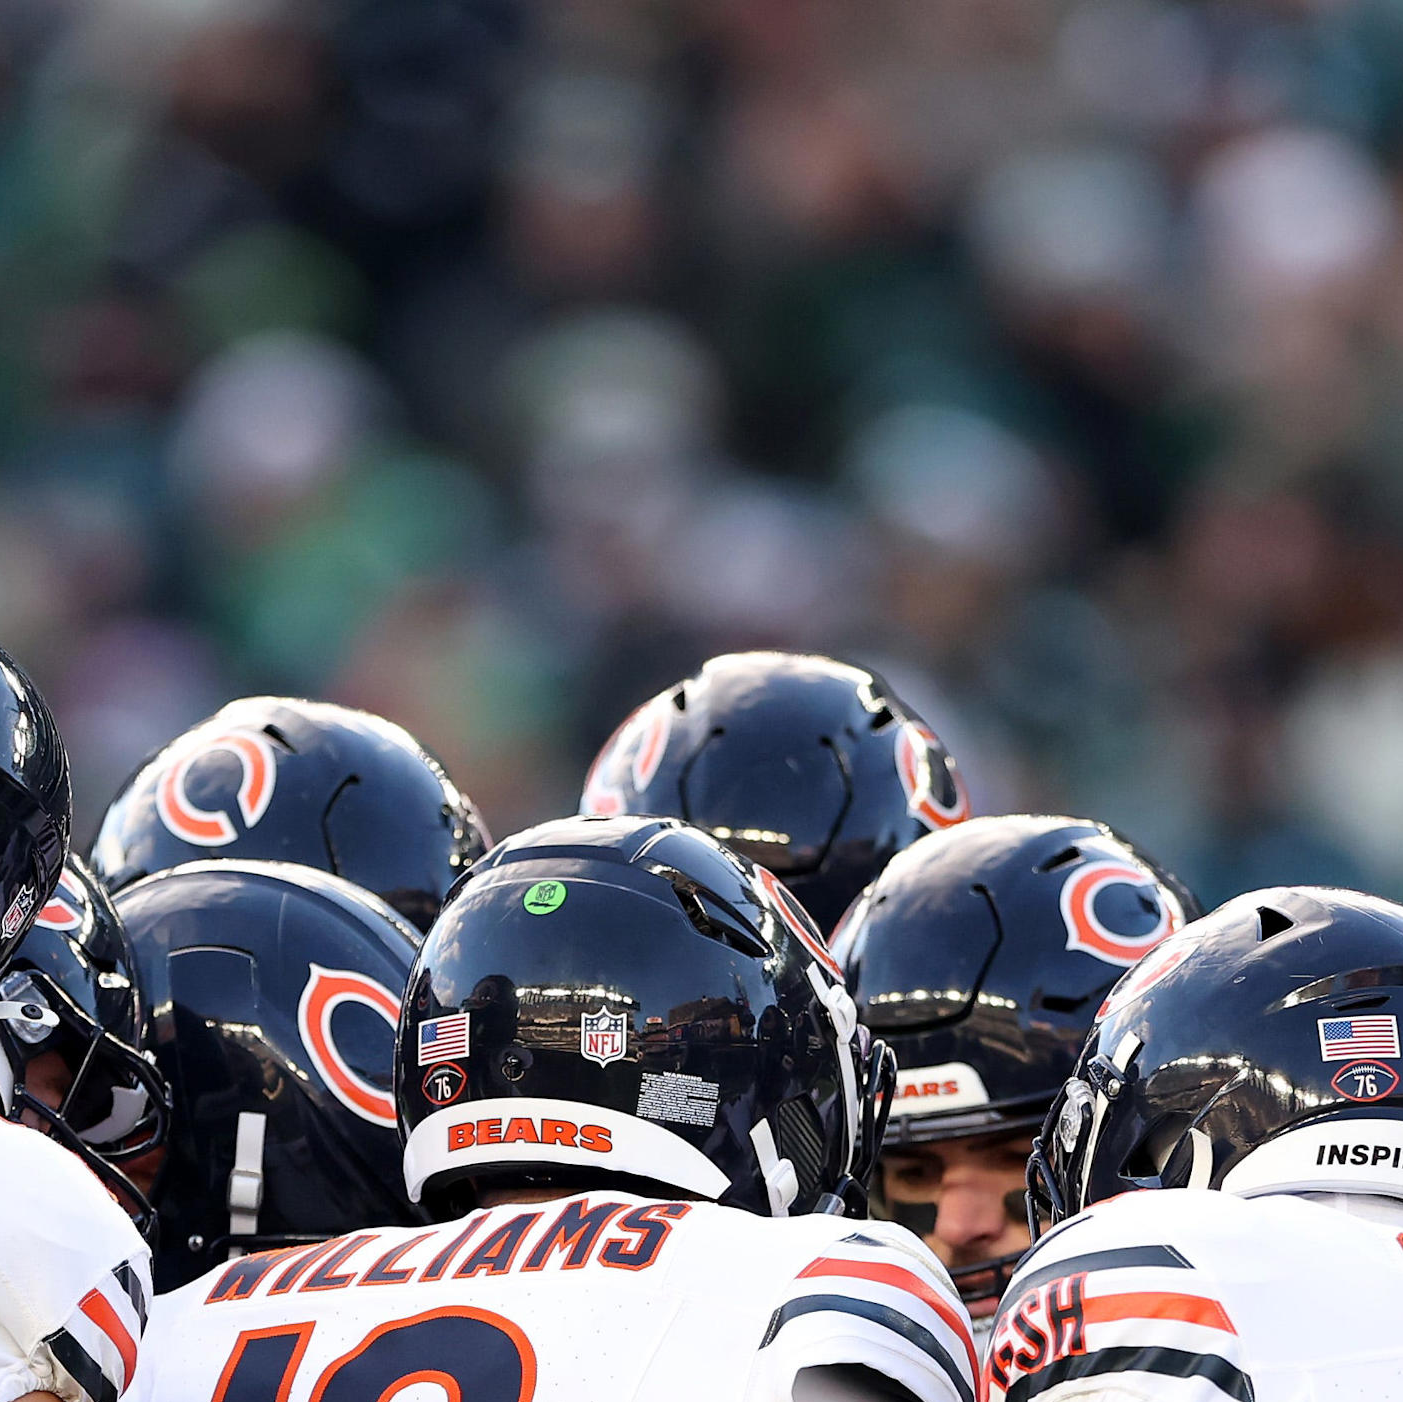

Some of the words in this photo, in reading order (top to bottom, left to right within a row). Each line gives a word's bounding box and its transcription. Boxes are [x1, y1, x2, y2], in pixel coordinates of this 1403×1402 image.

[587, 1030, 620, 1055] NFL
[434, 1077, 453, 1101] 76
[1354, 1074, 1378, 1098] 76
[447, 1118, 613, 1153] BEARS
[203, 1198, 693, 1306] WILLIAMS
